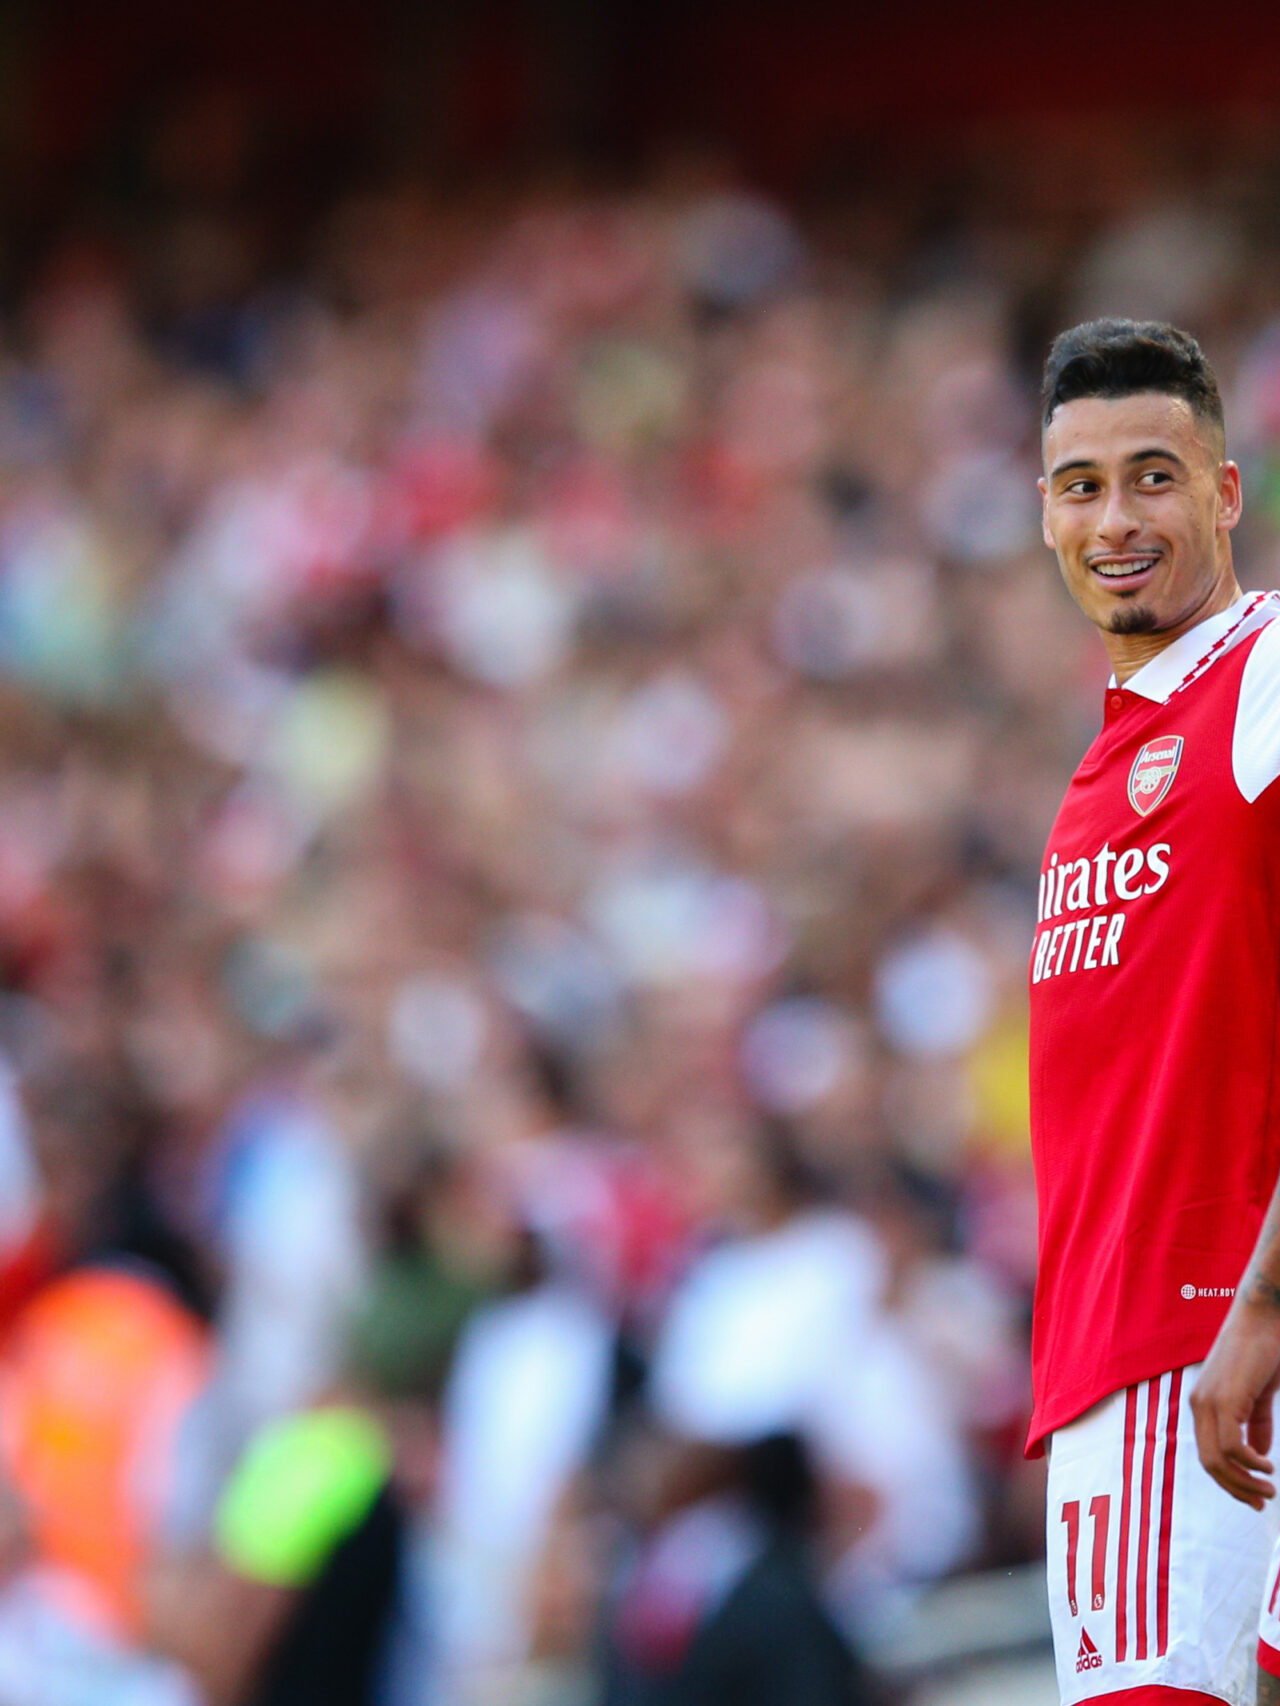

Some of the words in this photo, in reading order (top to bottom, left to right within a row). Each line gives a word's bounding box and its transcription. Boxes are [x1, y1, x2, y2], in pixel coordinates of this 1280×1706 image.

[1037, 841, 1172, 924] irates
[1032, 912, 1126, 984] BETTER
[1061, 1494, 1111, 1617] 11
